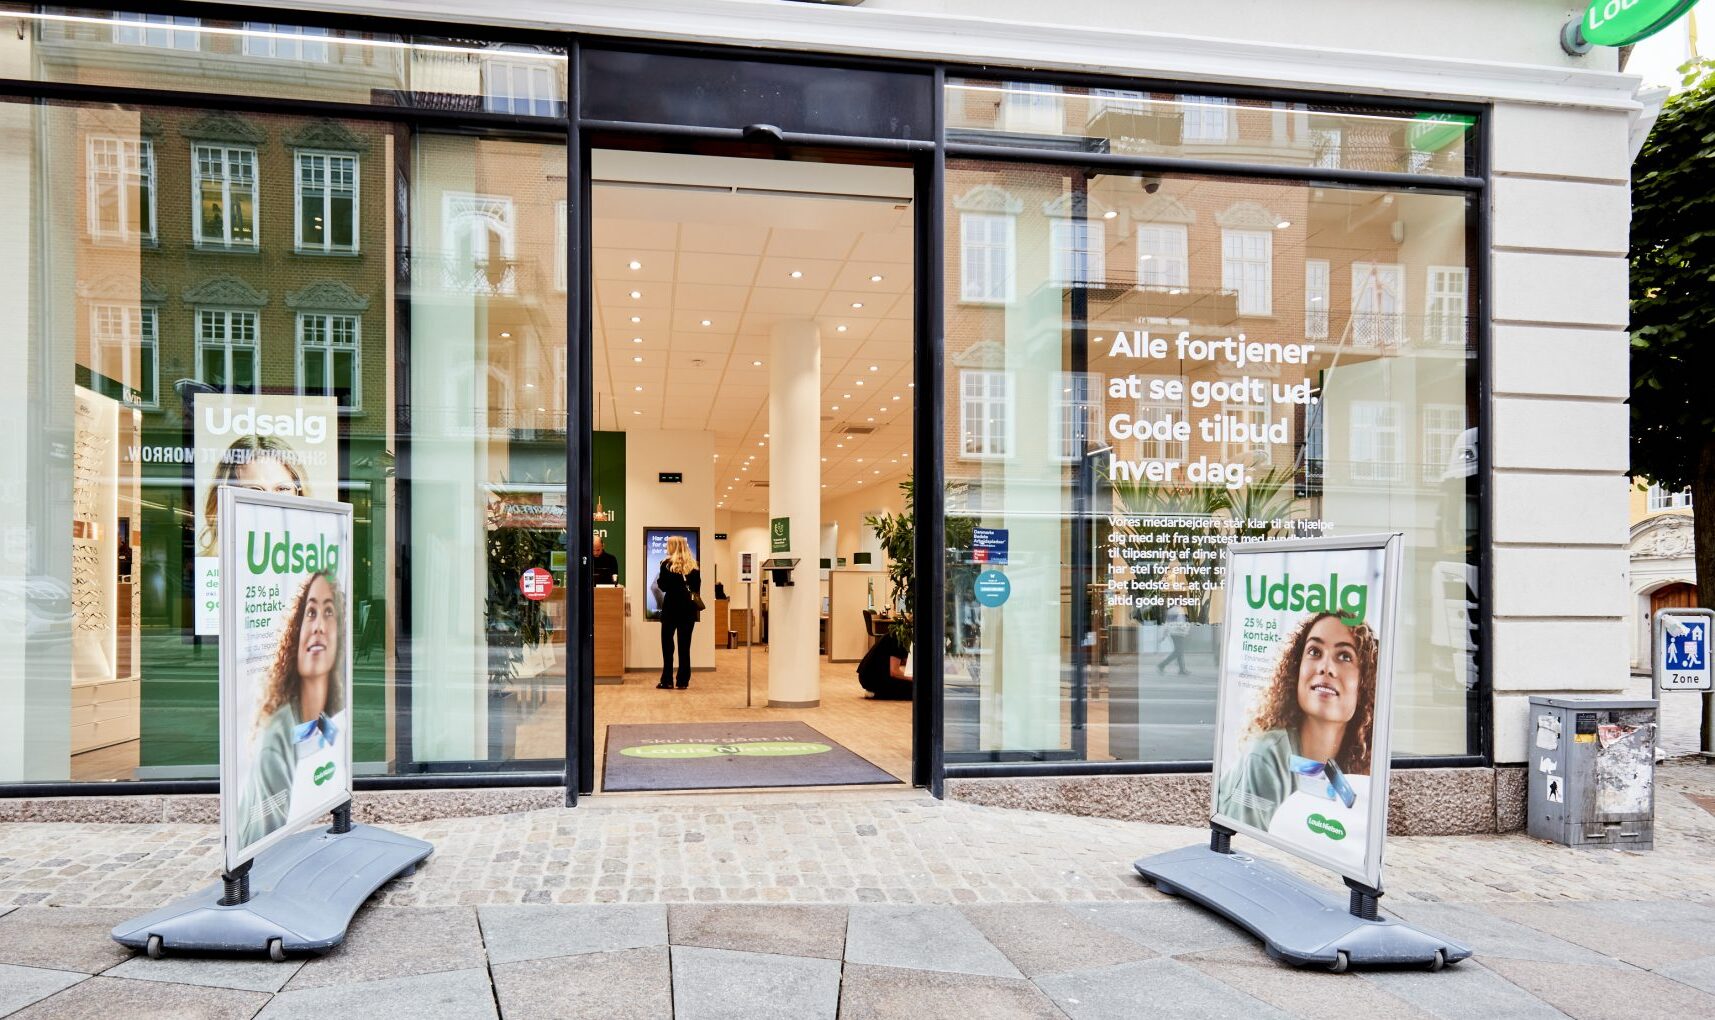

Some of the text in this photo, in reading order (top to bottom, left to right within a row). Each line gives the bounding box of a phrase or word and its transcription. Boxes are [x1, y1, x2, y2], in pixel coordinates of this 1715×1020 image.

[1108, 331, 1315, 368] Alle fortjener
[1108, 374, 1319, 408] at se godt ud.
[204, 406, 328, 444] Udsalg
[1108, 413, 1288, 444] Gode tilbud
[1109, 453, 1253, 490] hver dag.
[1107, 516, 1335, 532] Vores medarbejdere står klar til at hjælpe
[1107, 532, 1126, 545] dig
[1128, 532, 1154, 543] med
[1155, 532, 1171, 543] alt
[1172, 532, 1190, 544] fra
[1191, 533, 1239, 545] synstest
[246, 530, 340, 582] Udsalg
[1107, 548, 1120, 559] til
[1122, 548, 1177, 561] tilpasning
[1178, 549, 1191, 559] af
[1192, 549, 1217, 559] dine
[1107, 563, 1126, 575] har
[1131, 564, 1150, 575] stel
[1153, 564, 1169, 575] for
[1172, 564, 1211, 575] enhver
[245, 586, 256, 598] 25
[268, 584, 280, 600] på
[1107, 580, 1129, 590] Det
[1131, 580, 1170, 590] bedste
[1188, 581, 1200, 590] at
[1202, 580, 1217, 590] du
[244, 599, 286, 614] kontakt-
[1107, 595, 1133, 606] altid
[1135, 595, 1165, 608] gode
[1245, 572, 1368, 627] Udsalg
[245, 615, 271, 629] linser
[1244, 617, 1255, 628] 25
[1265, 618, 1277, 631] på
[1243, 629, 1282, 642] kontakt-
[1242, 640, 1268, 653] linser
[1672, 673, 1700, 684] Zone
